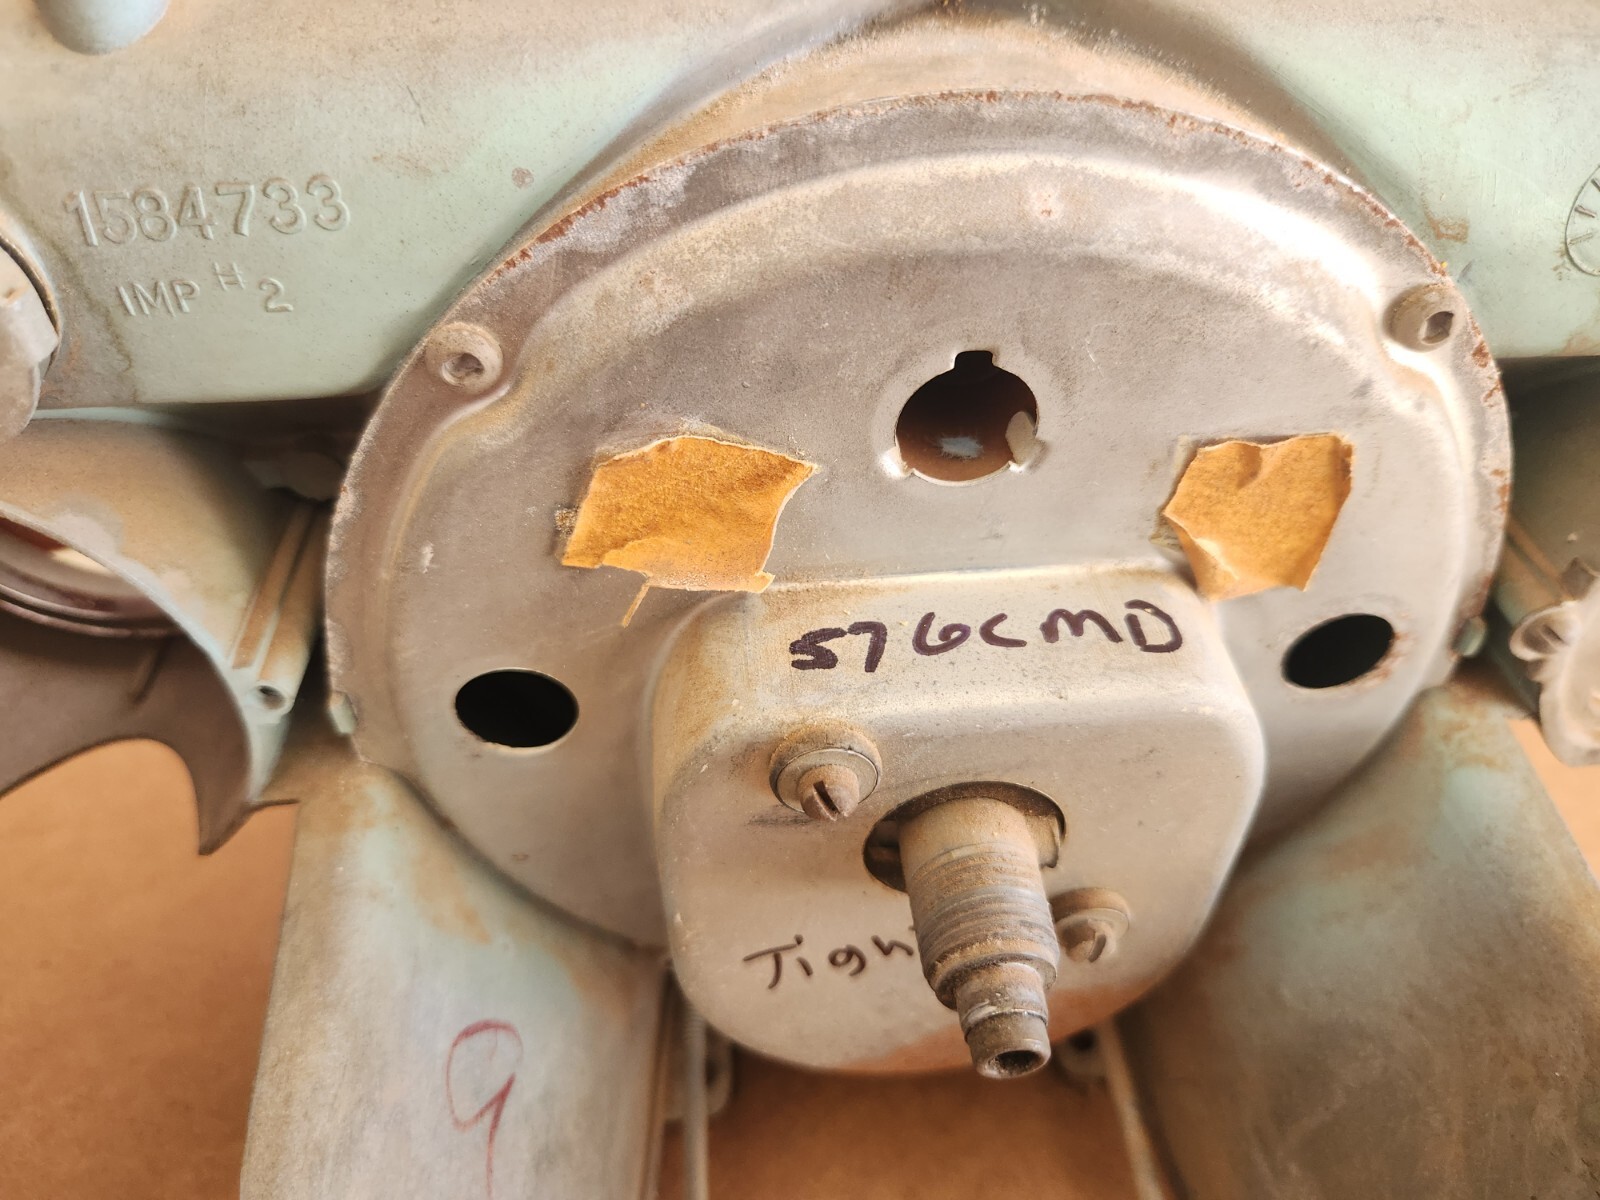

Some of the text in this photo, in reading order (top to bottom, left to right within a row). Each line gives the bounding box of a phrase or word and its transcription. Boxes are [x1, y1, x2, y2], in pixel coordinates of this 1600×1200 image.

[64, 174, 350, 246] 1584733
[116, 279, 200, 317] IMP
[258, 276, 295, 313] 2
[742, 925, 916, 989] Tigh
[446, 1019, 524, 1200] 9
